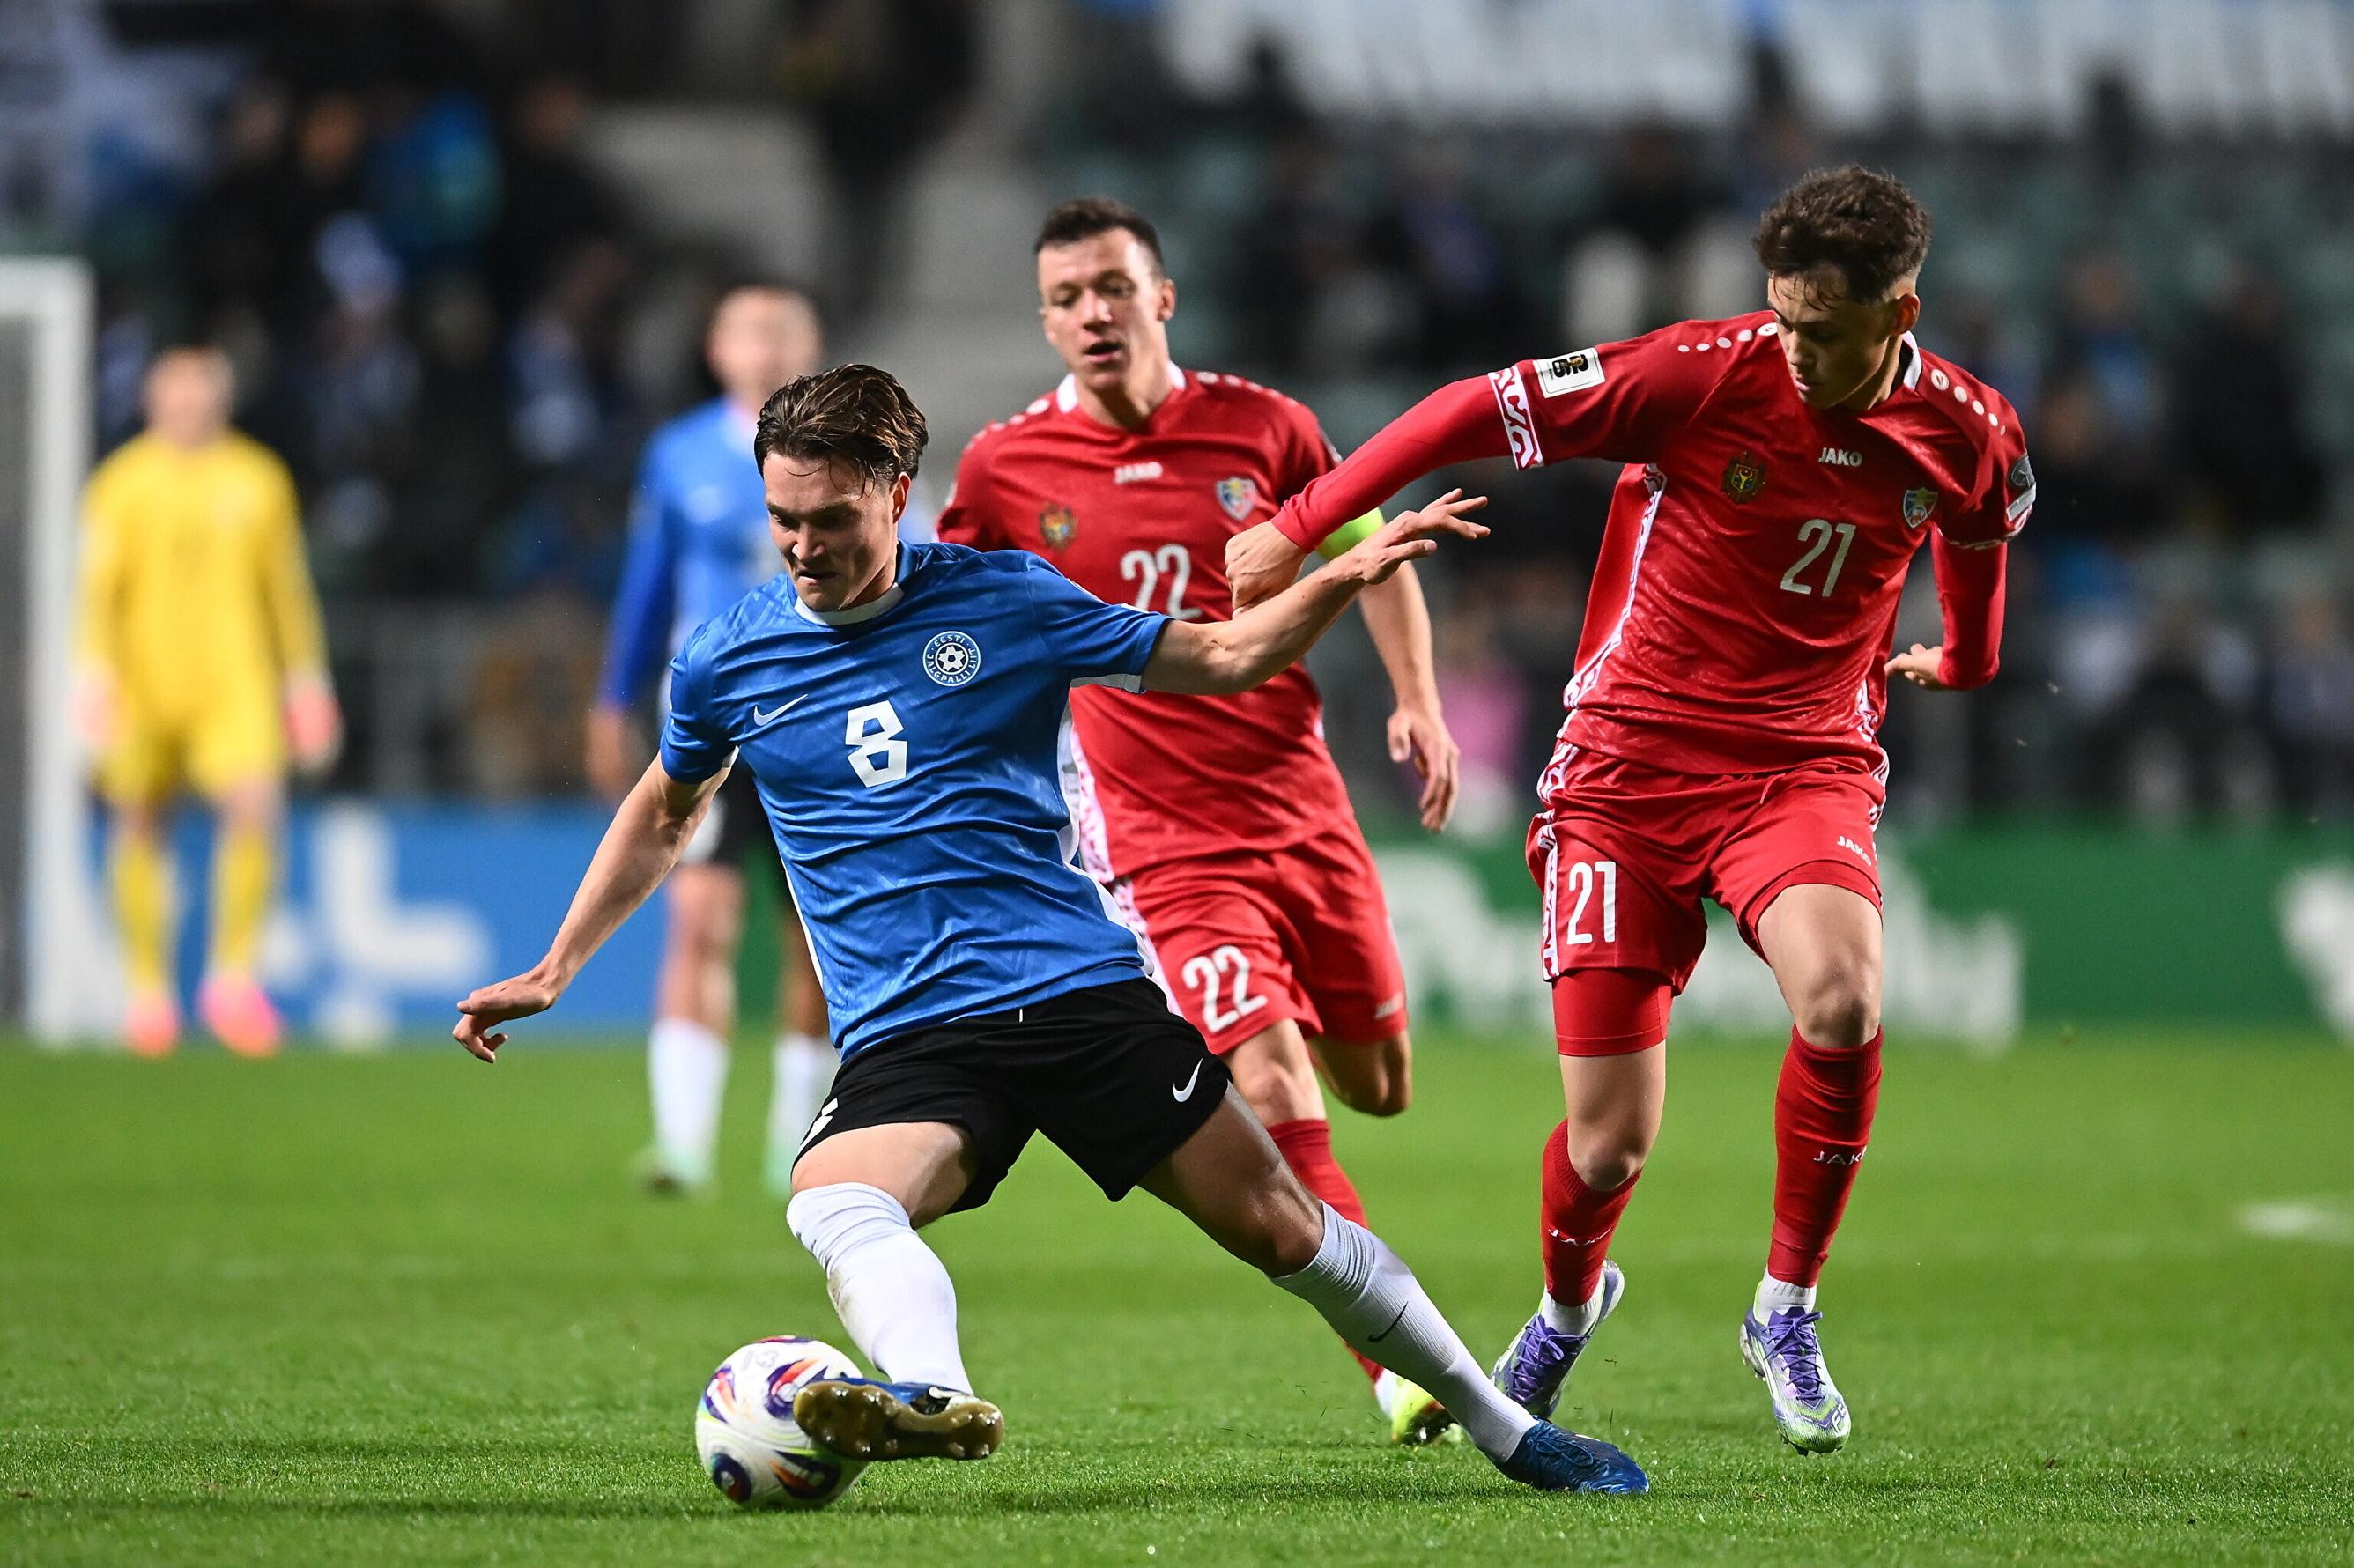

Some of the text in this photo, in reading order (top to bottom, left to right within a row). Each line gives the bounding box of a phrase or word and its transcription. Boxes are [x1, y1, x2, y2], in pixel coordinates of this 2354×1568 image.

[1818, 447, 1862, 467] JAKO
[1120, 544, 1203, 620] 22
[1780, 518, 1857, 597] 21
[926, 647, 978, 684] JALGPALLI LIIT
[934, 634, 966, 647] EESTI
[845, 699, 908, 788] 8
[1837, 835, 1872, 867] JAKO
[1566, 860, 1617, 946] 21
[1181, 945, 1267, 1032] 22
[1813, 1145, 1867, 1165] JAK
